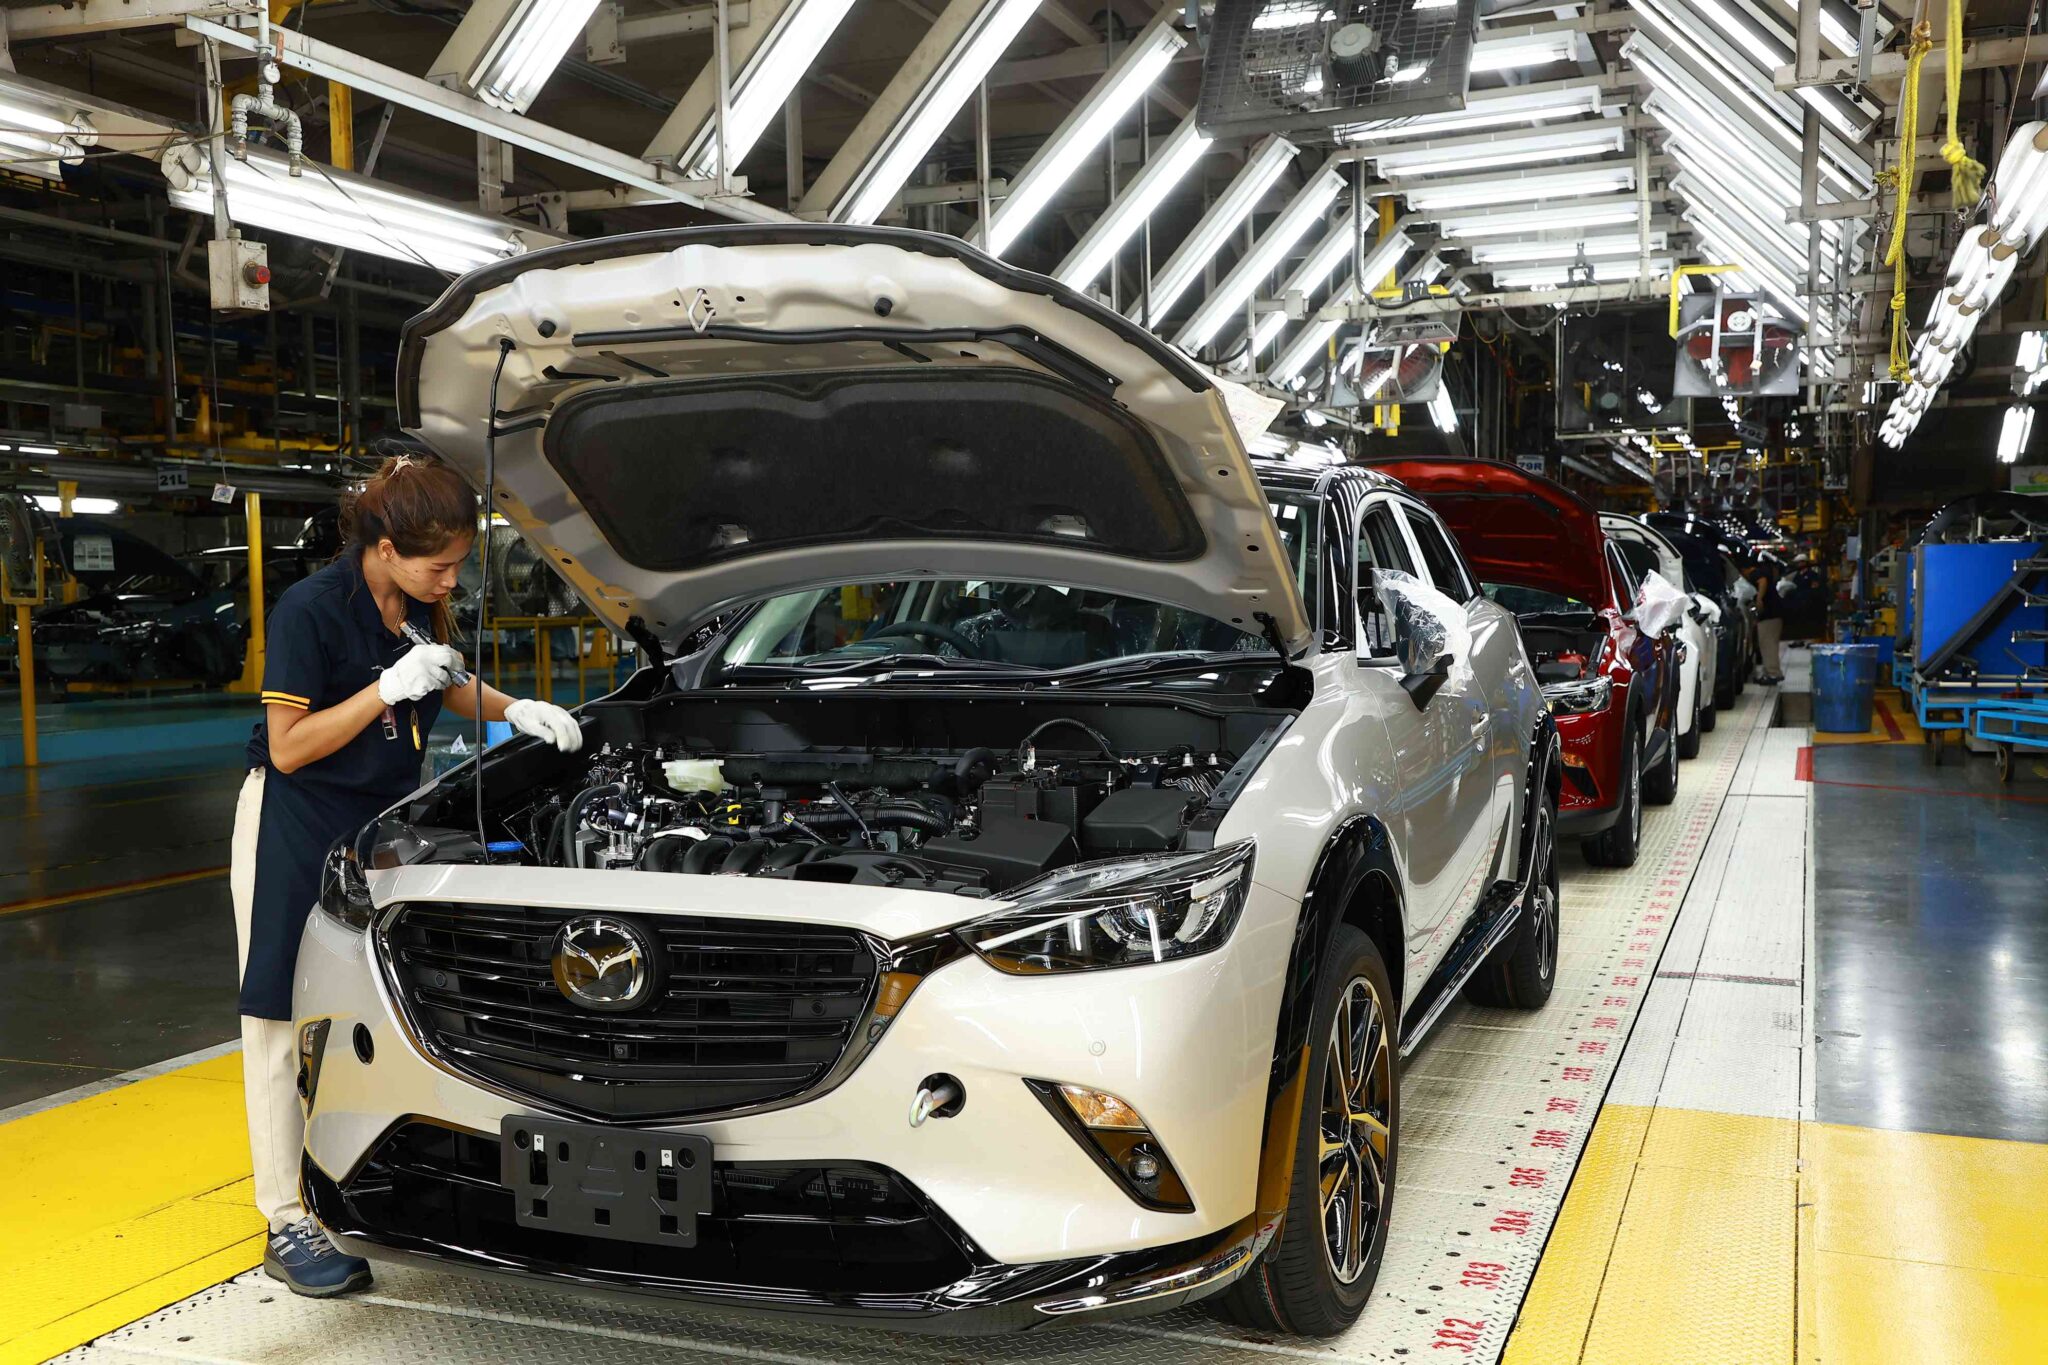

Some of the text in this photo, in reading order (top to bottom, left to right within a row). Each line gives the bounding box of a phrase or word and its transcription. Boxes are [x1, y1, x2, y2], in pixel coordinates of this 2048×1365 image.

[159, 474, 186, 486] 21L
[1546, 1097, 1578, 1113] 387
[1530, 1129, 1569, 1148] 386
[1508, 1167, 1548, 1188] 385
[1490, 1210, 1534, 1236] 384
[1459, 1261, 1506, 1290] 383
[1432, 1318, 1487, 1353] 382
